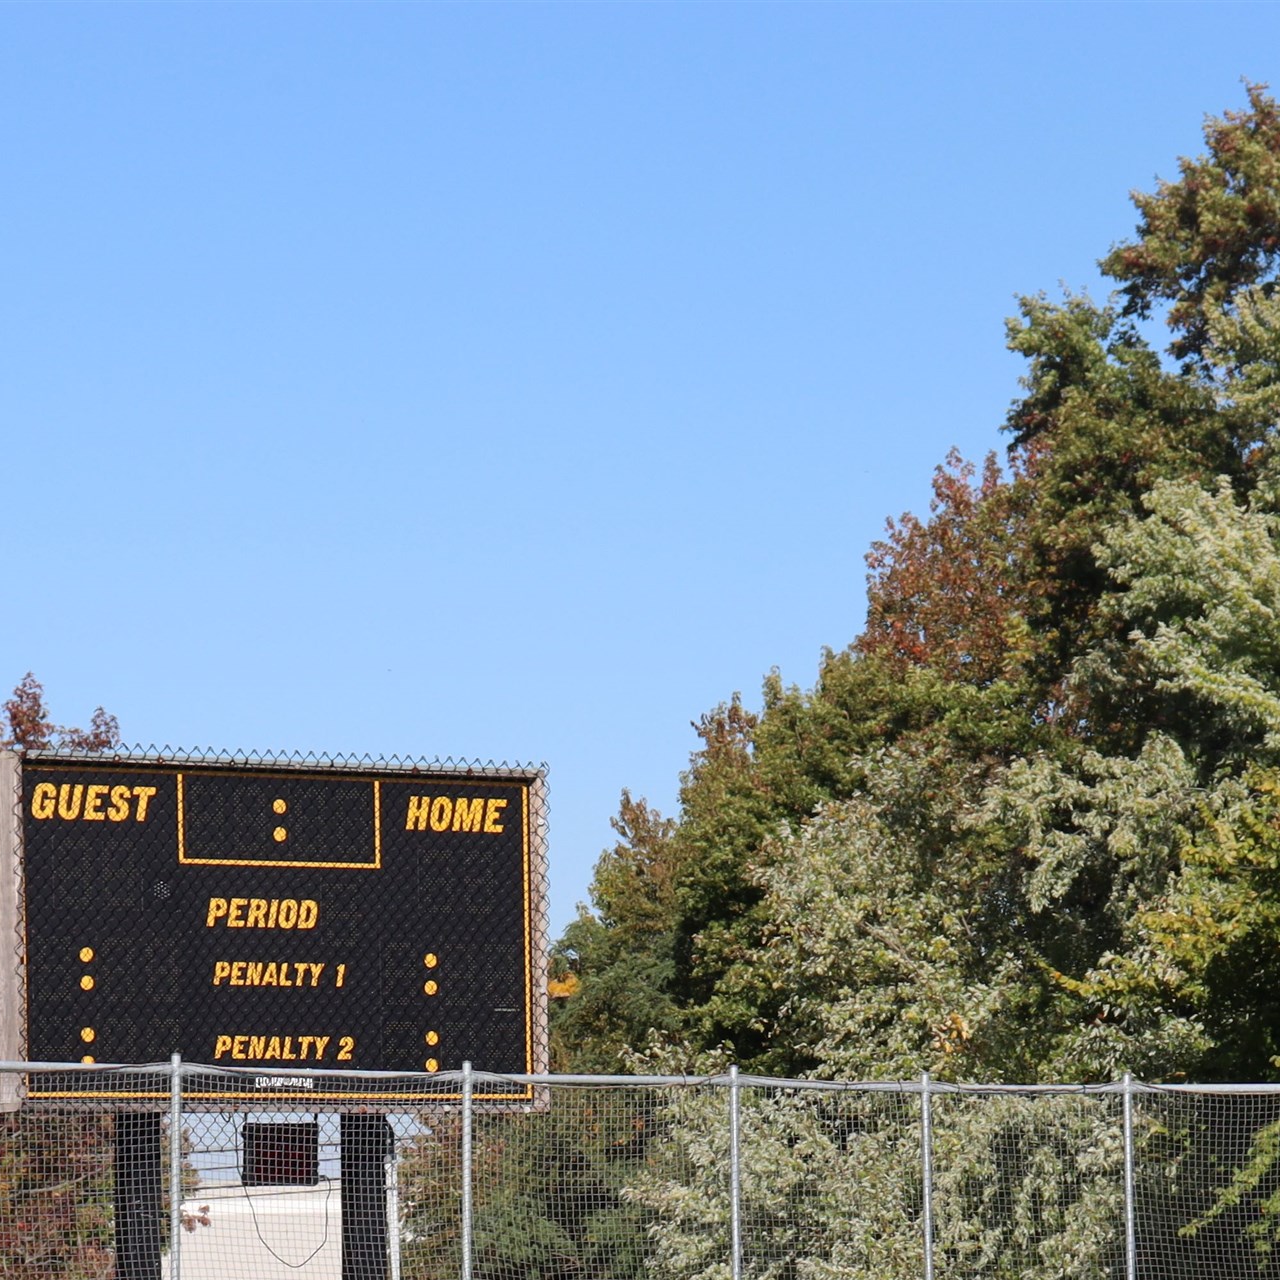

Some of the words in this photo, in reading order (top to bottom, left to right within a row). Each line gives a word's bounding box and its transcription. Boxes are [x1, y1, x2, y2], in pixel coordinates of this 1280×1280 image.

[31, 782, 157, 822] GUEST
[405, 796, 508, 834] HOME
[206, 897, 319, 930] PERIOD
[213, 961, 325, 988] PENALTY
[335, 963, 347, 988] 1
[214, 1035, 328, 1061] PENALTY
[337, 1036, 356, 1061] 2
